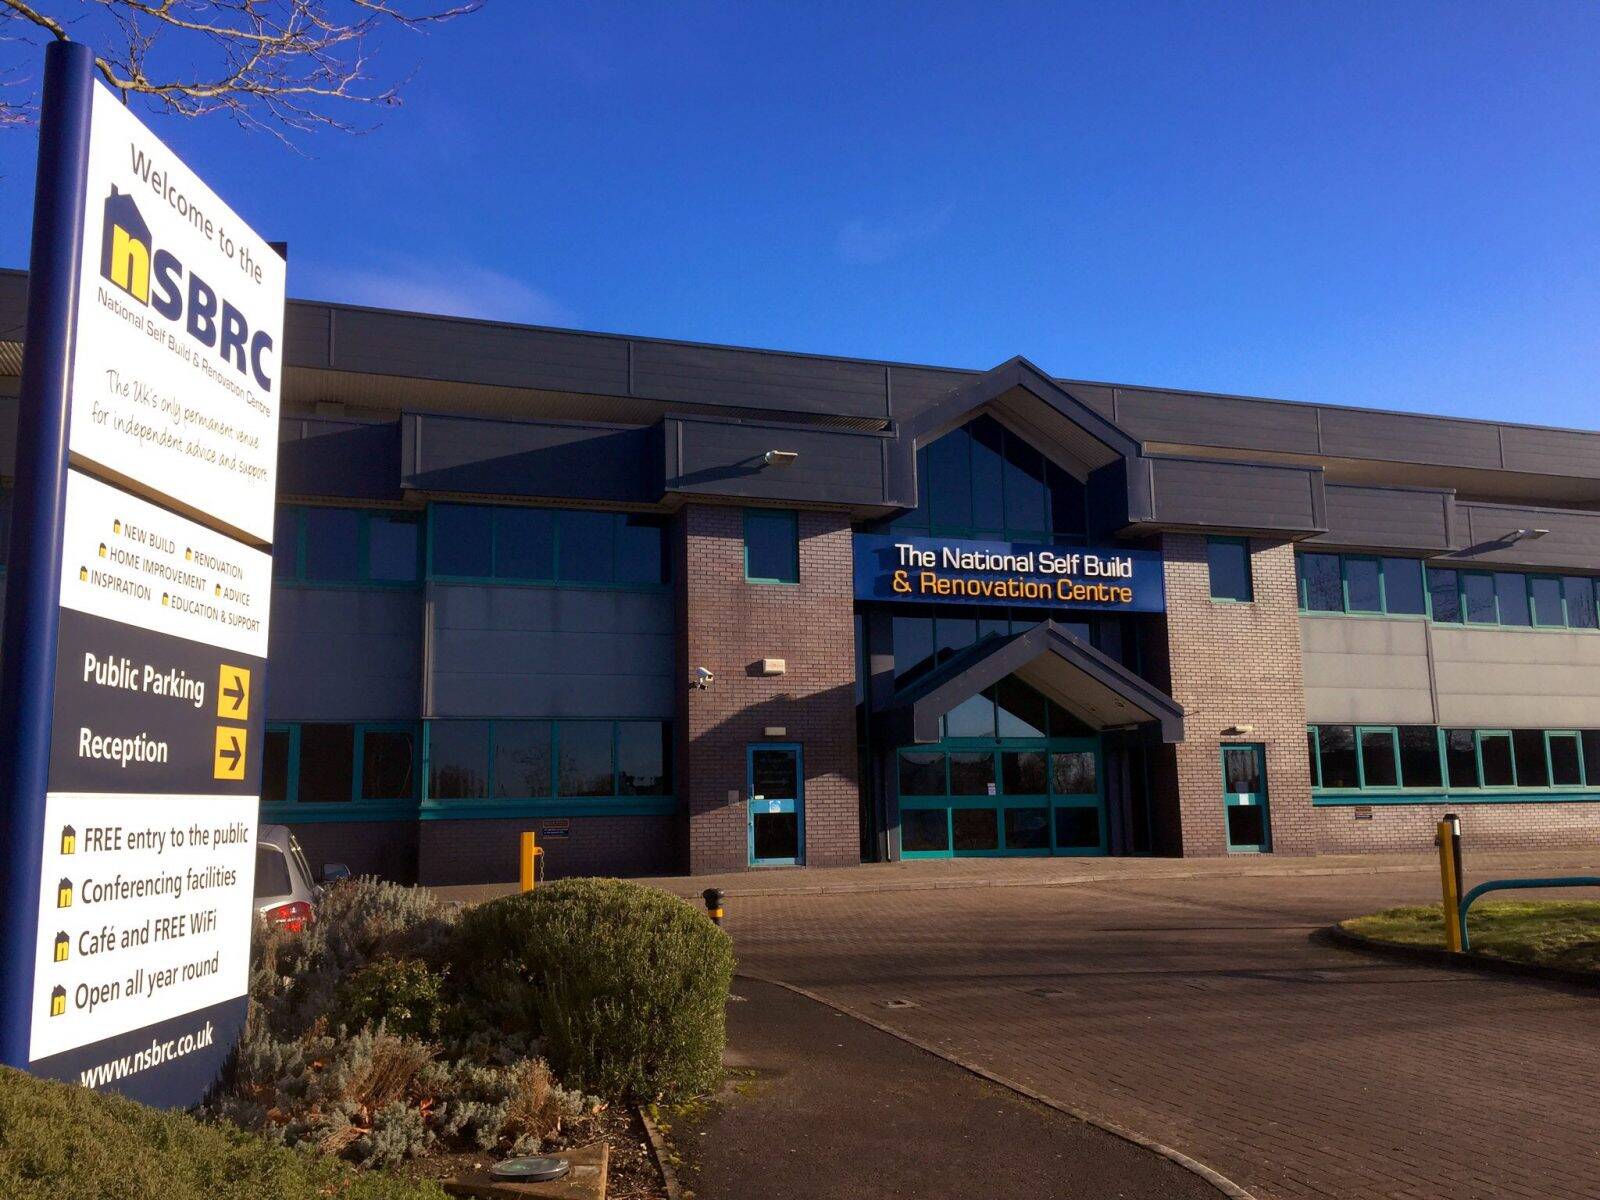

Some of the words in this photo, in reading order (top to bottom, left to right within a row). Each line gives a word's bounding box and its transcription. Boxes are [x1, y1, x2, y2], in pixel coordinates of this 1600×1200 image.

[131, 142, 213, 241] Welcome
[219, 228, 235, 259] to
[240, 246, 262, 284] the
[98, 286, 144, 331] National
[147, 320, 165, 347] Self
[168, 334, 190, 362] Build
[193, 352, 199, 368] &
[202, 357, 244, 401] Renovation
[246, 390, 271, 418] Centre
[106, 369, 129, 397] The
[161, 396, 181, 425] only
[92, 400, 109, 425] for
[114, 410, 182, 452] independent
[219, 450, 237, 471] and
[124, 523, 147, 544] NEW
[149, 533, 176, 554] BUILD
[110, 546, 140, 570] HOME
[143, 558, 206, 591] IMPROVEMENT
[194, 551, 243, 580] RENOVATION
[895, 543, 935, 568] The
[942, 547, 1033, 573] National
[1038, 551, 1079, 575] Self
[1084, 554, 1132, 578] Build
[91, 569, 152, 601] INSPIRATION
[223, 587, 250, 607] ADVICE
[892, 570, 912, 593] &
[920, 571, 1052, 599] Renovation
[1057, 578, 1132, 603] Centre
[171, 595, 218, 620] EDUCATION
[221, 610, 226, 623] &
[228, 612, 260, 632] SUPPORT
[83, 652, 139, 691] Public
[143, 664, 205, 708] Parking
[78, 727, 168, 768] Reception
[84, 827, 122, 852] FREE
[127, 827, 166, 855] entry
[170, 825, 184, 847] to
[189, 823, 209, 846] the
[213, 821, 249, 850] public
[81, 871, 182, 904] Conferencing
[186, 865, 237, 892] facilities
[78, 925, 115, 957] Café
[121, 919, 149, 949] and
[154, 914, 186, 942] FREE
[190, 908, 217, 934] WiFi
[75, 981, 120, 1014] Open
[125, 968, 143, 998] all
[148, 966, 179, 998] year
[182, 950, 219, 981] round
[80, 1020, 214, 1089] www.nsbrc.co.uk
